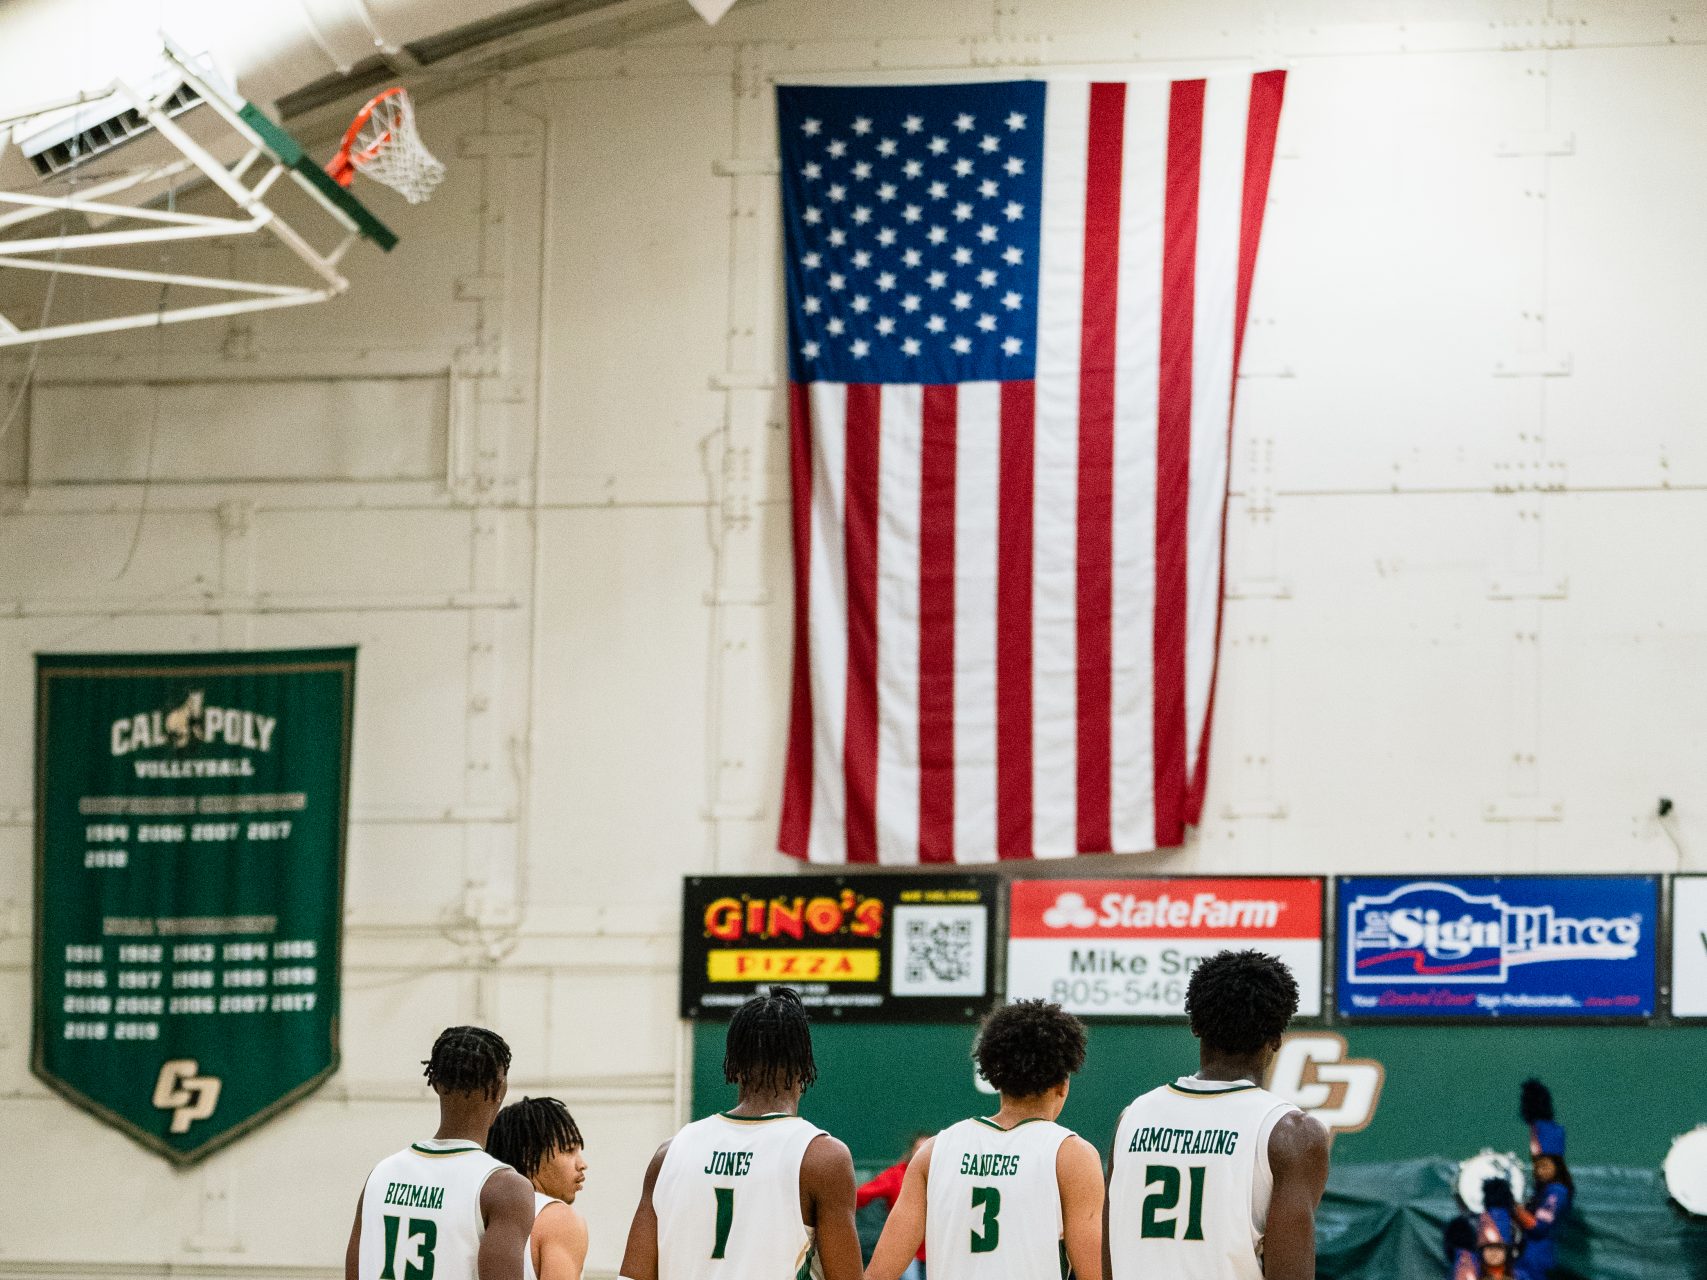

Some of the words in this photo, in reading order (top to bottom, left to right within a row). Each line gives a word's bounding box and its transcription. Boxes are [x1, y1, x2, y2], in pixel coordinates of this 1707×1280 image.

[111, 710, 167, 757] CAL
[204, 706, 277, 752] POLY
[134, 758, 255, 779] VOLLEYBALL
[704, 889, 884, 941] GINO'S
[1390, 908, 1500, 960] Sign
[1502, 906, 1640, 952] Place
[737, 954, 855, 976] PIZZA
[1070, 949, 1148, 975] Mike
[1129, 1127, 1239, 1156] ARMOTRADING
[704, 1150, 753, 1177] JONES
[960, 1152, 1020, 1177] SANDERS
[384, 1182, 445, 1210] BIZIMANA
[1140, 1164, 1206, 1241] 21
[710, 1186, 734, 1260] 1
[970, 1186, 1001, 1253] 3
